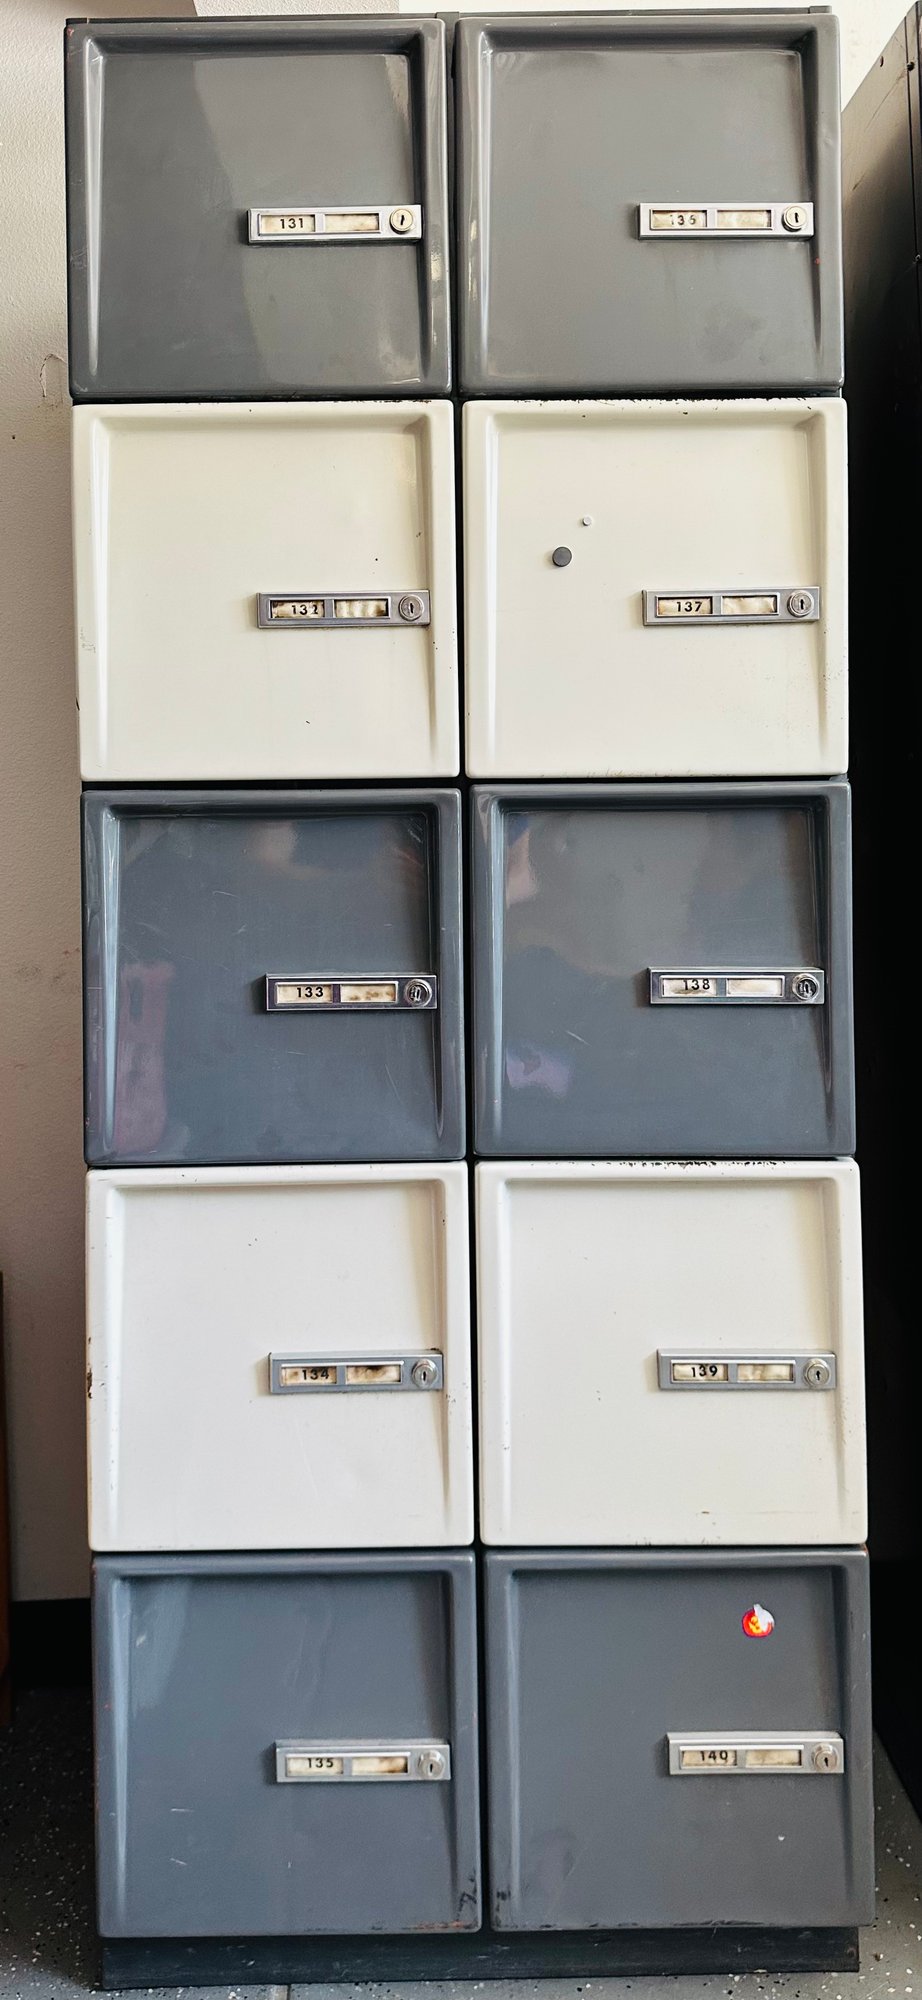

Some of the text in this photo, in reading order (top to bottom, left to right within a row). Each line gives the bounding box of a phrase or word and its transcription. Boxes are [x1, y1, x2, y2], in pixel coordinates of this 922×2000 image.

[280, 218, 304, 229] 131
[292, 604, 318, 616] 132
[676, 601, 702, 612] 137
[684, 978, 710, 990] 138
[296, 986, 324, 998] 133
[302, 1368, 329, 1380] 134
[692, 1365, 718, 1377] 139
[700, 1750, 728, 1761] 140
[308, 1758, 334, 1768] 135
